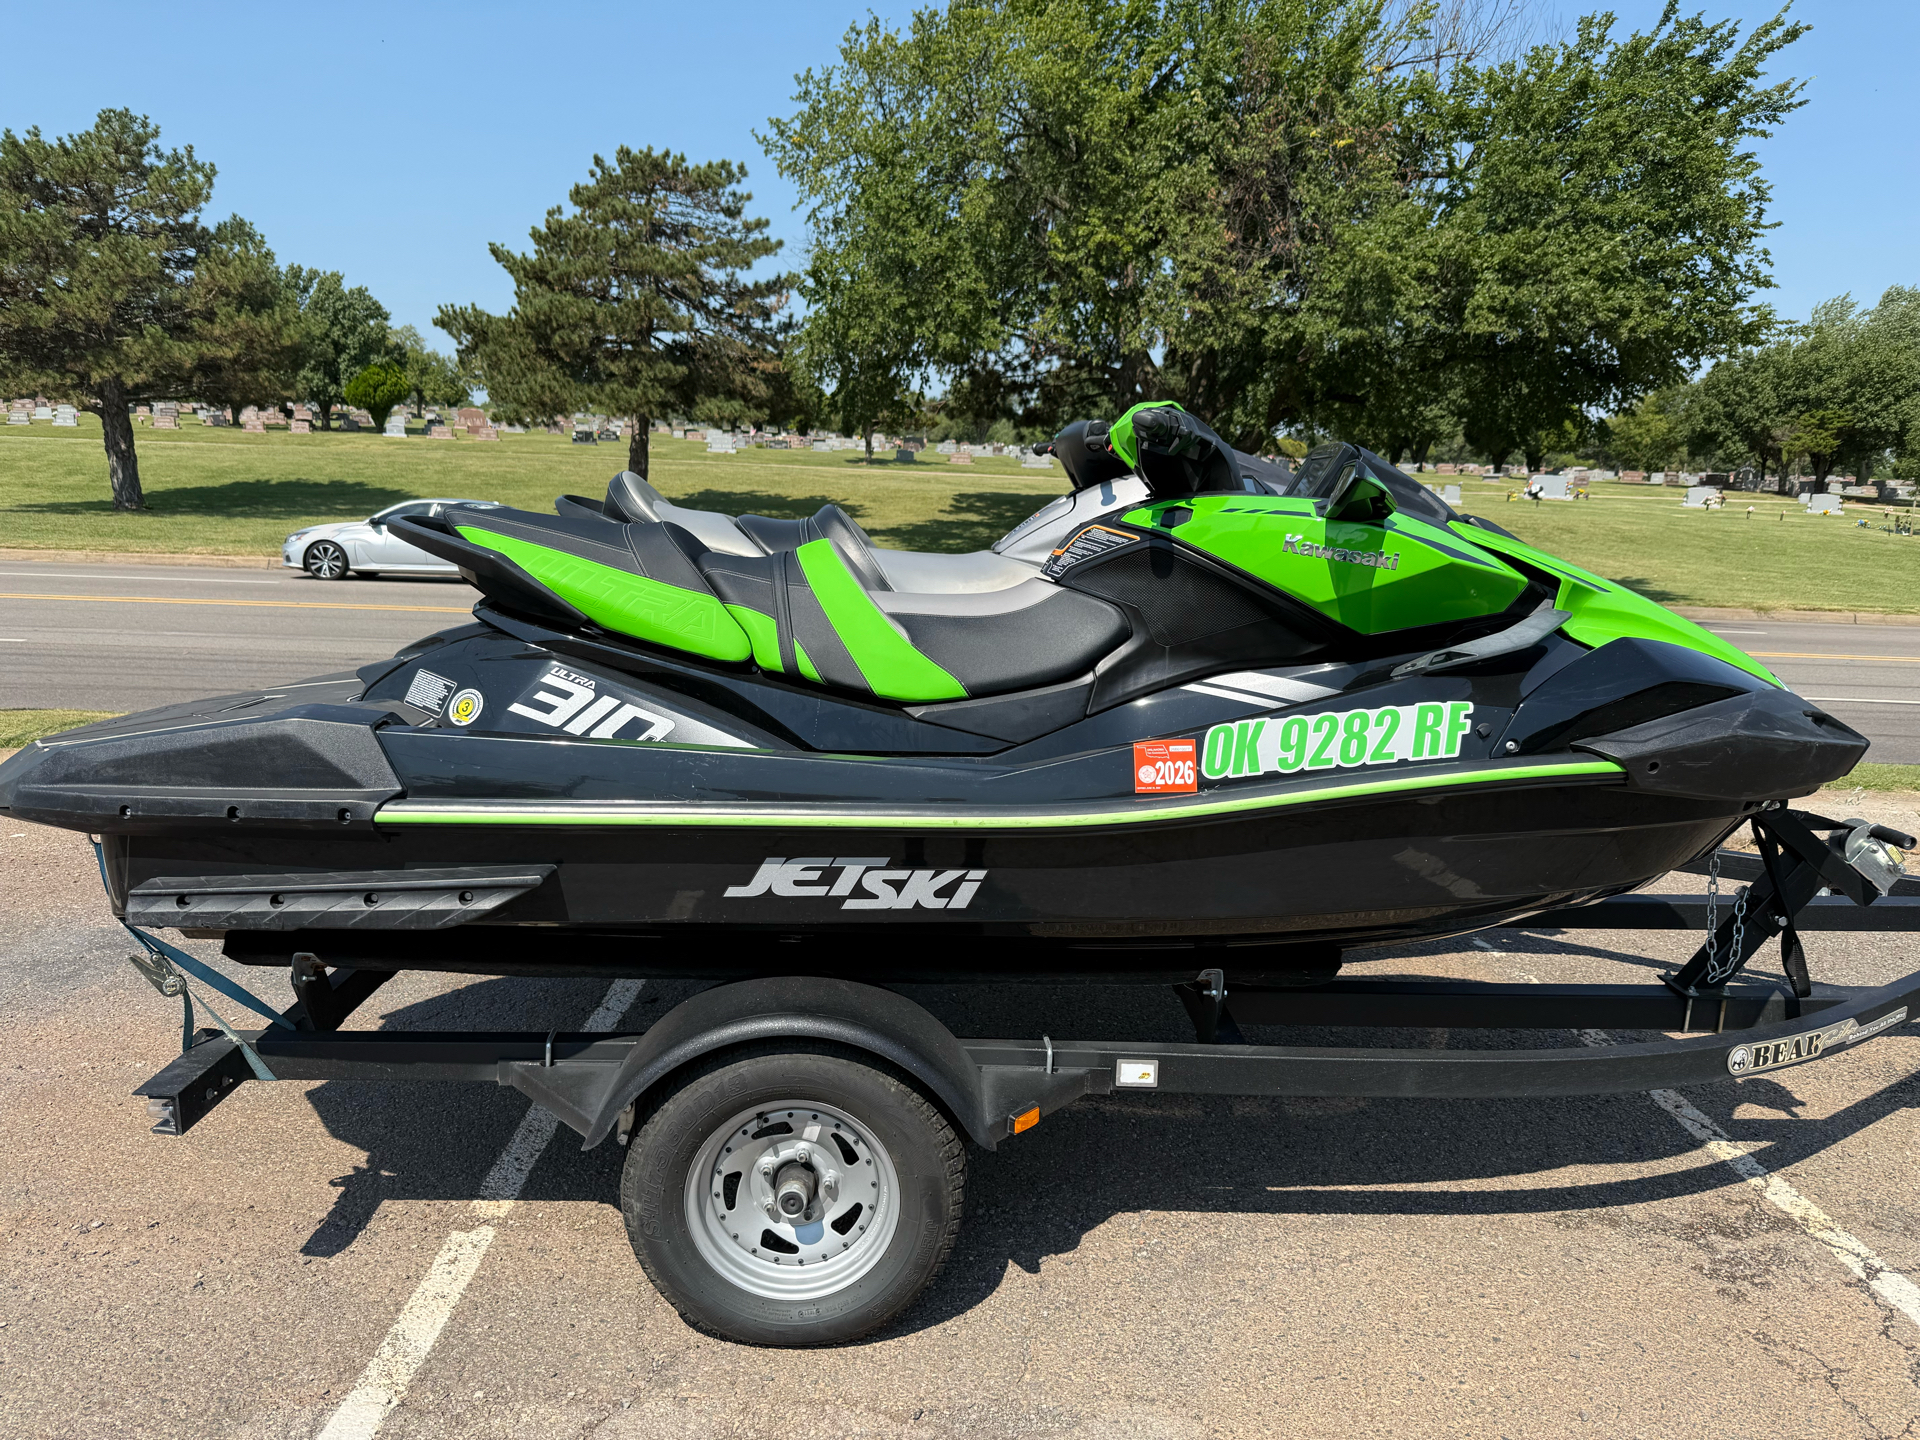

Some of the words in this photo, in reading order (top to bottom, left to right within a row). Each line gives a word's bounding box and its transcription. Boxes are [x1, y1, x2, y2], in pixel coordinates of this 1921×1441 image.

[1282, 533, 1400, 571] Kawasaki
[524, 554, 716, 642] ULTRA
[550, 667, 596, 690] ULTRA
[461, 701, 471, 713] 3
[507, 673, 677, 741] 310
[1204, 719, 1268, 778] OK
[1276, 708, 1401, 771] 9282
[1410, 702, 1471, 759] RF
[1154, 760, 1194, 785] 2026
[723, 857, 891, 897] JET
[1749, 1032, 1823, 1069] BEAR
